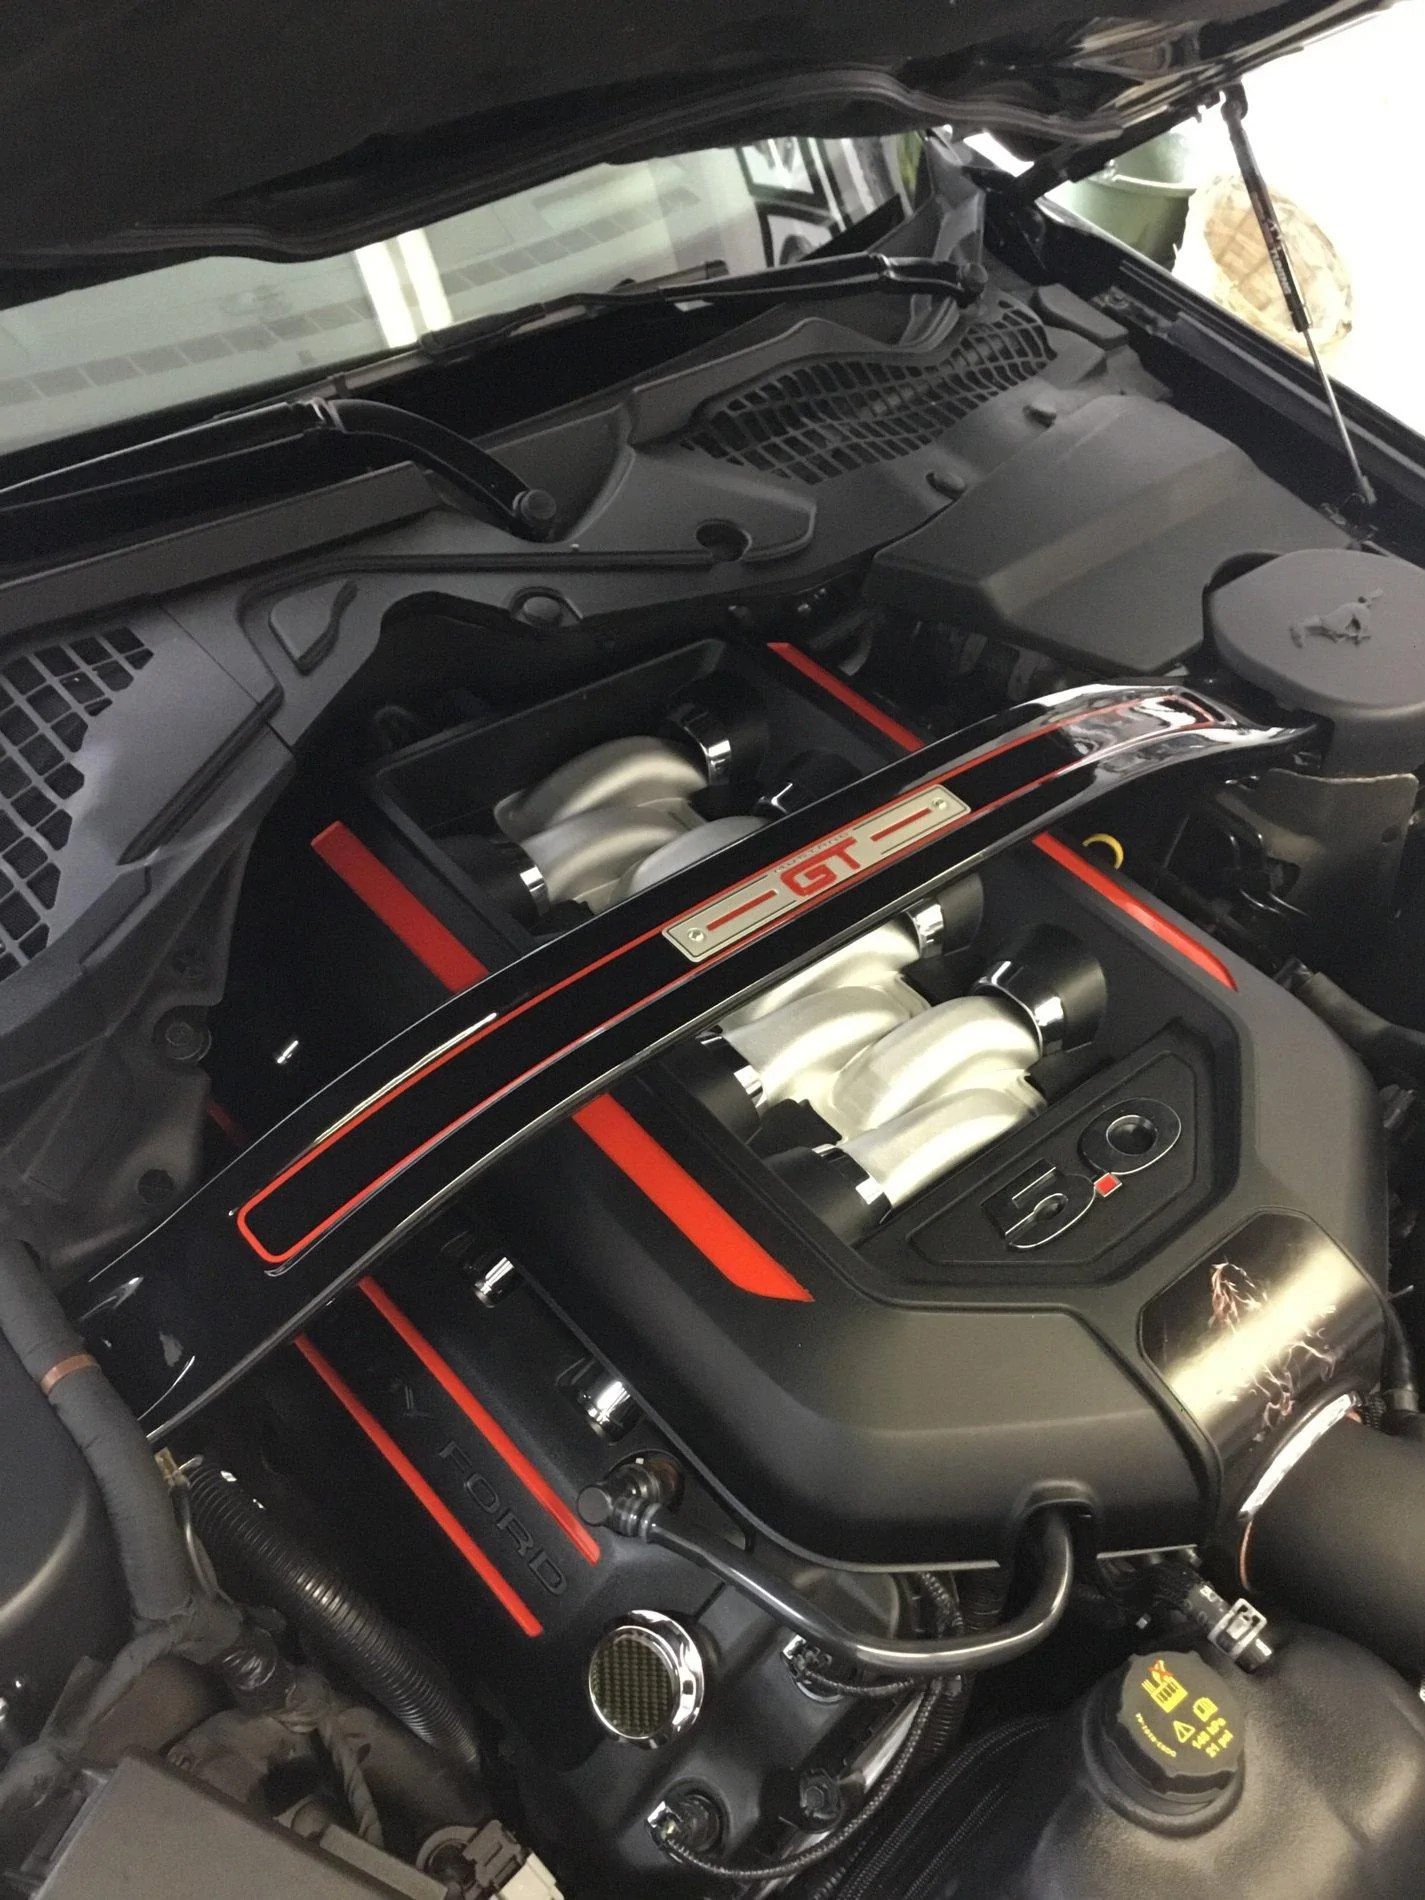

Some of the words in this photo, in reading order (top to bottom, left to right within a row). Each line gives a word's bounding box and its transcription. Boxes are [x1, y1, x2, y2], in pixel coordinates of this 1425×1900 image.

[779, 836, 861, 897] GT
[980, 1097, 1182, 1249] 5.0
[438, 1440, 568, 1596] FORD
